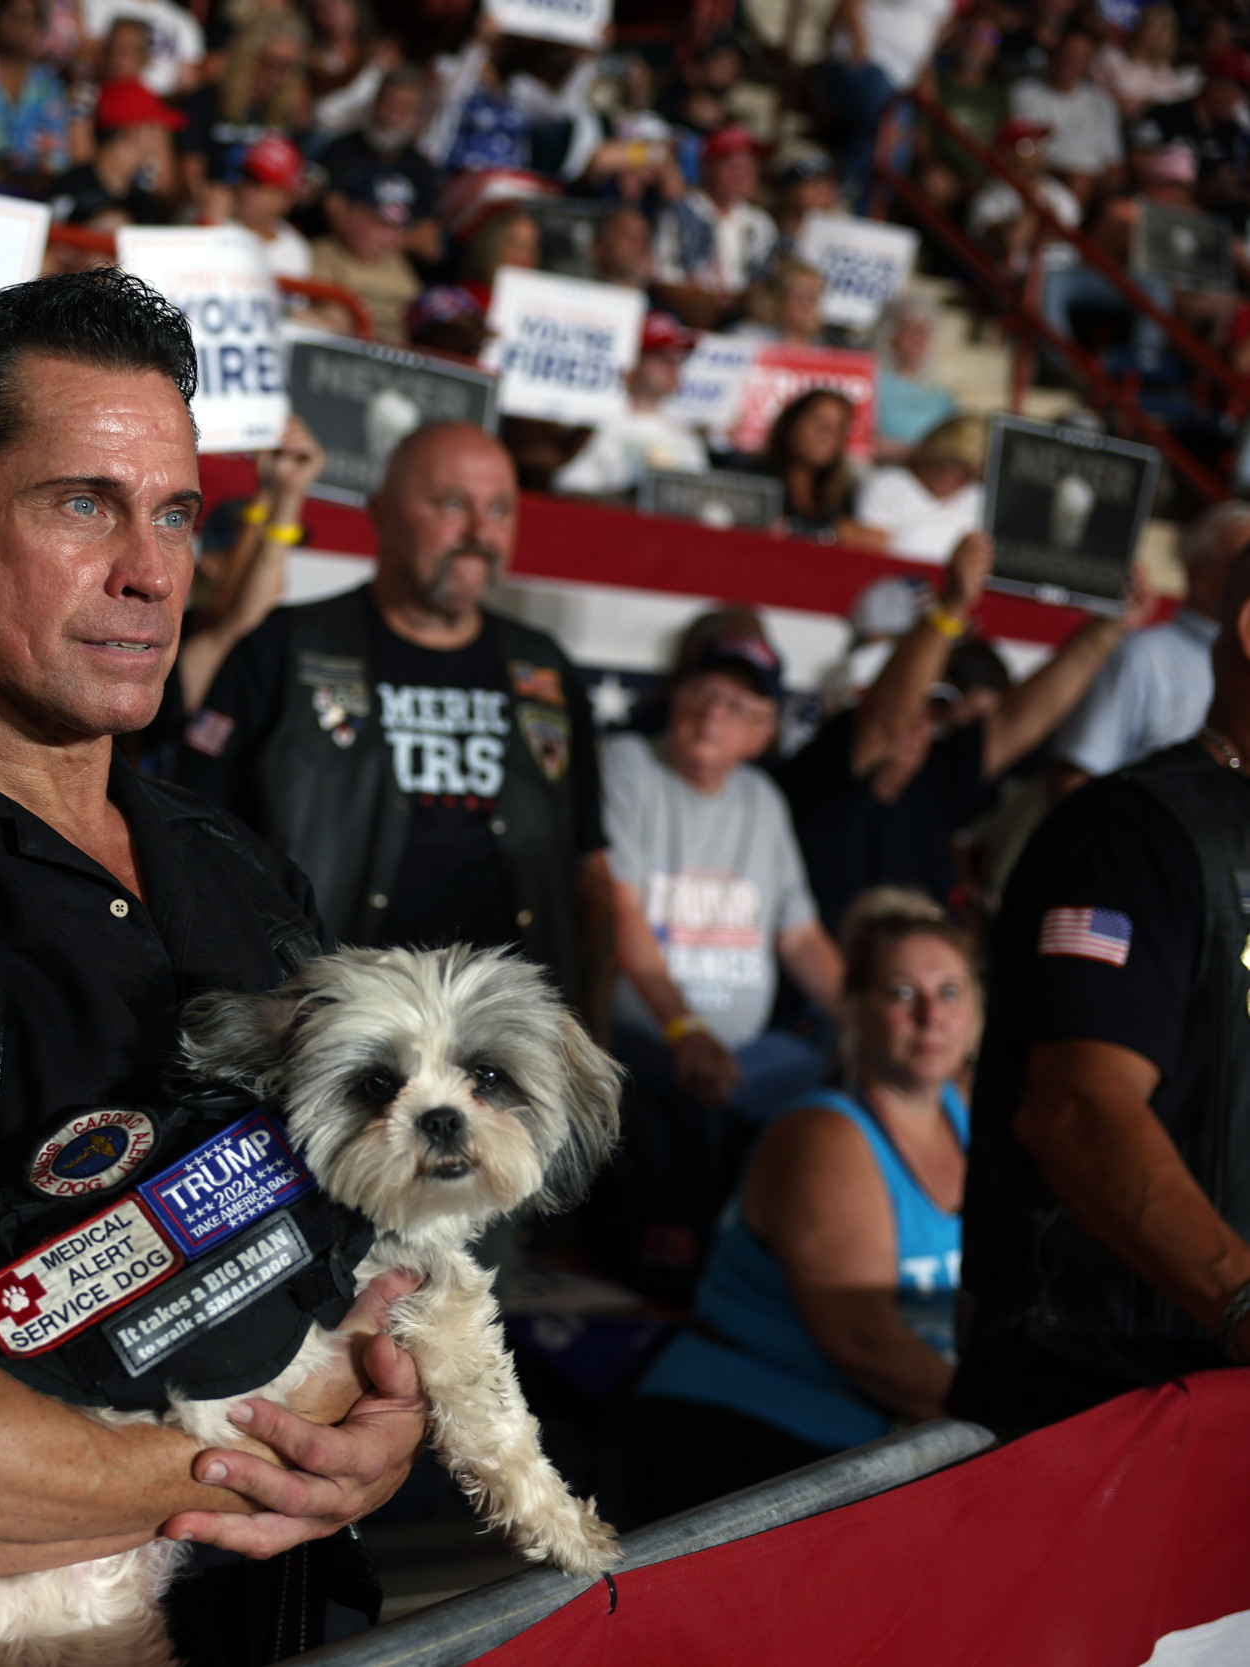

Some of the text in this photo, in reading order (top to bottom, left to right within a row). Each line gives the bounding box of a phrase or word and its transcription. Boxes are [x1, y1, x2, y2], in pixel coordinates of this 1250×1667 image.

[32, 1143, 103, 1195] SERVICE DOG
[73, 1113, 151, 1176] CARDIAC ALERT
[161, 1129, 271, 1210] TRUMP
[190, 1166, 299, 1238] TAKE AMERICA BACK
[213, 1172, 256, 1208] 2024
[40, 1214, 132, 1271] MEDICAL
[68, 1235, 136, 1287] ALERT
[11, 1249, 168, 1348] SERVICE DOG
[117, 1228, 290, 1348] It takes a BIG MAN
[137, 1252, 293, 1360] to walk a SMALL DOG
